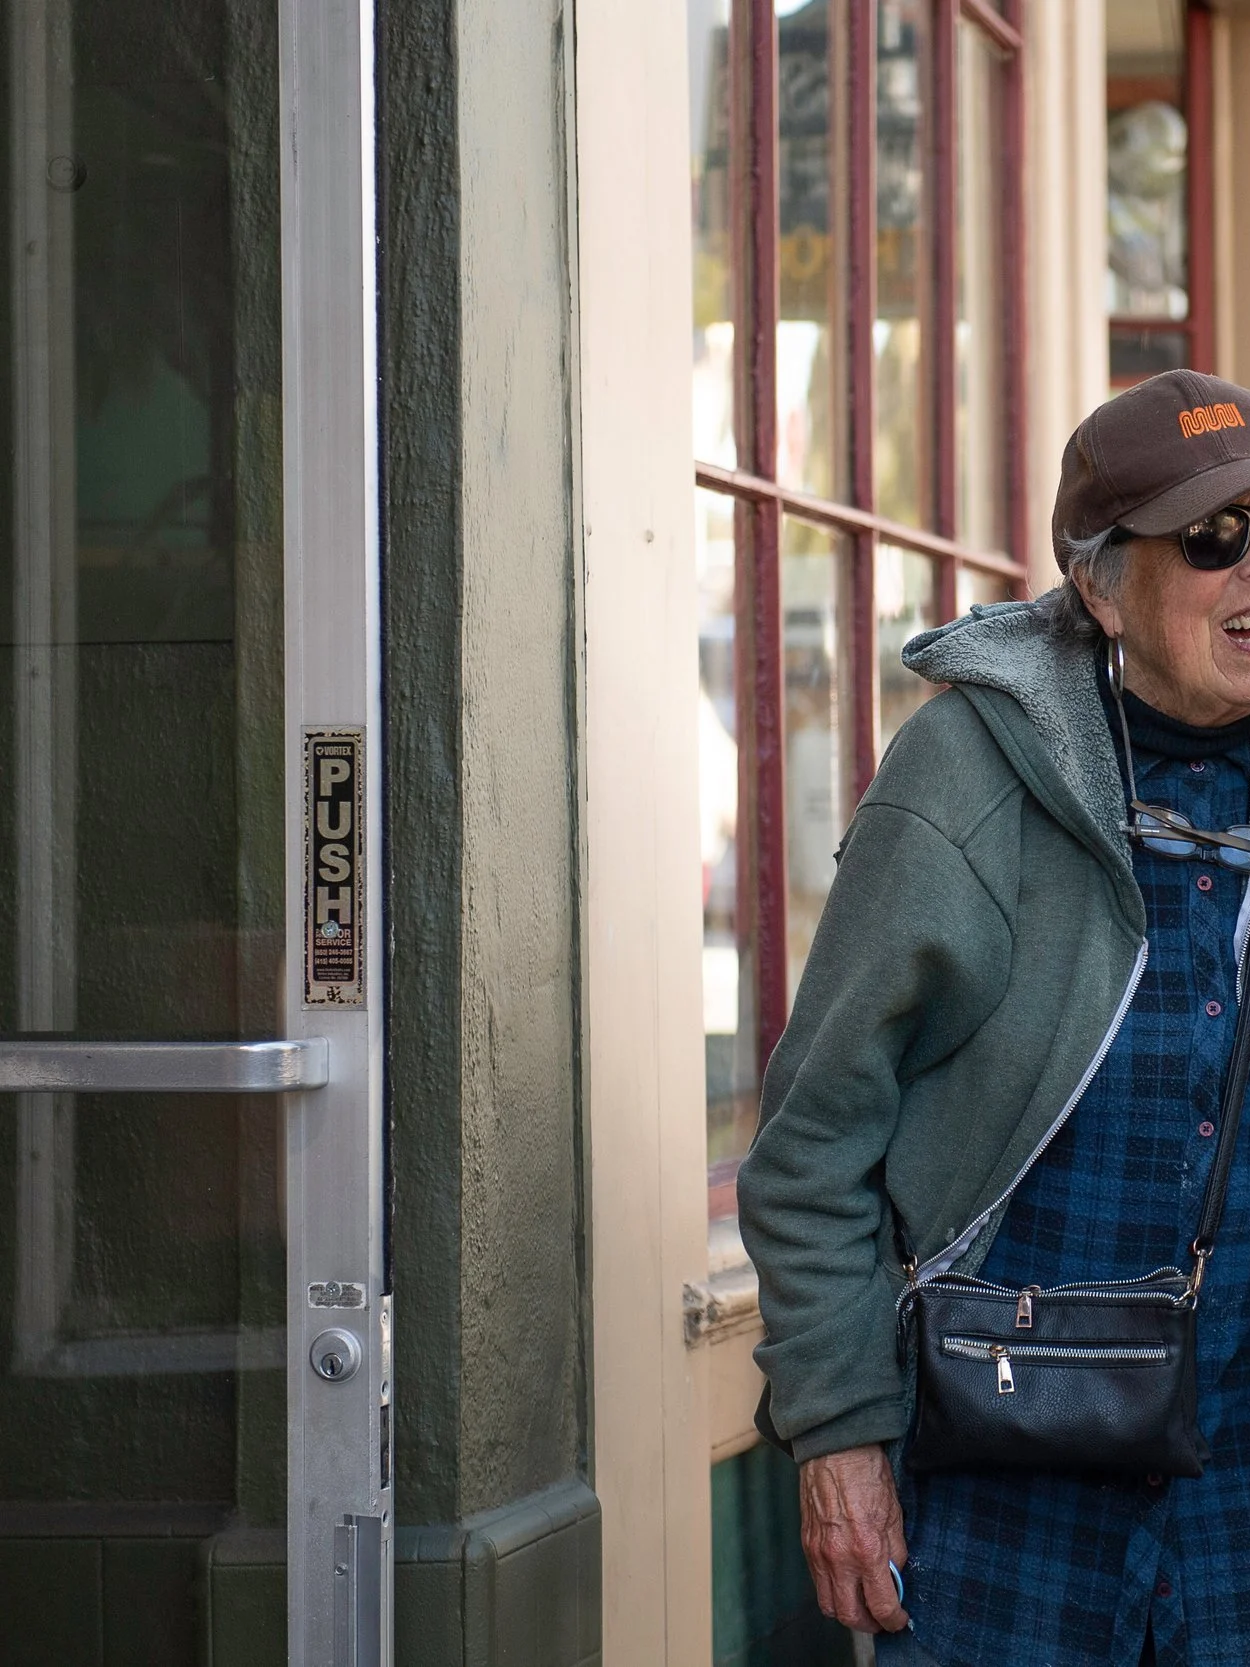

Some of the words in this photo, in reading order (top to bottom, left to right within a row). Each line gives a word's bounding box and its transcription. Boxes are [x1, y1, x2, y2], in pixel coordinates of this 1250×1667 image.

[324, 746, 352, 756] VORTEX
[316, 758, 351, 924] PUSH
[316, 938, 352, 946] SERVICE
